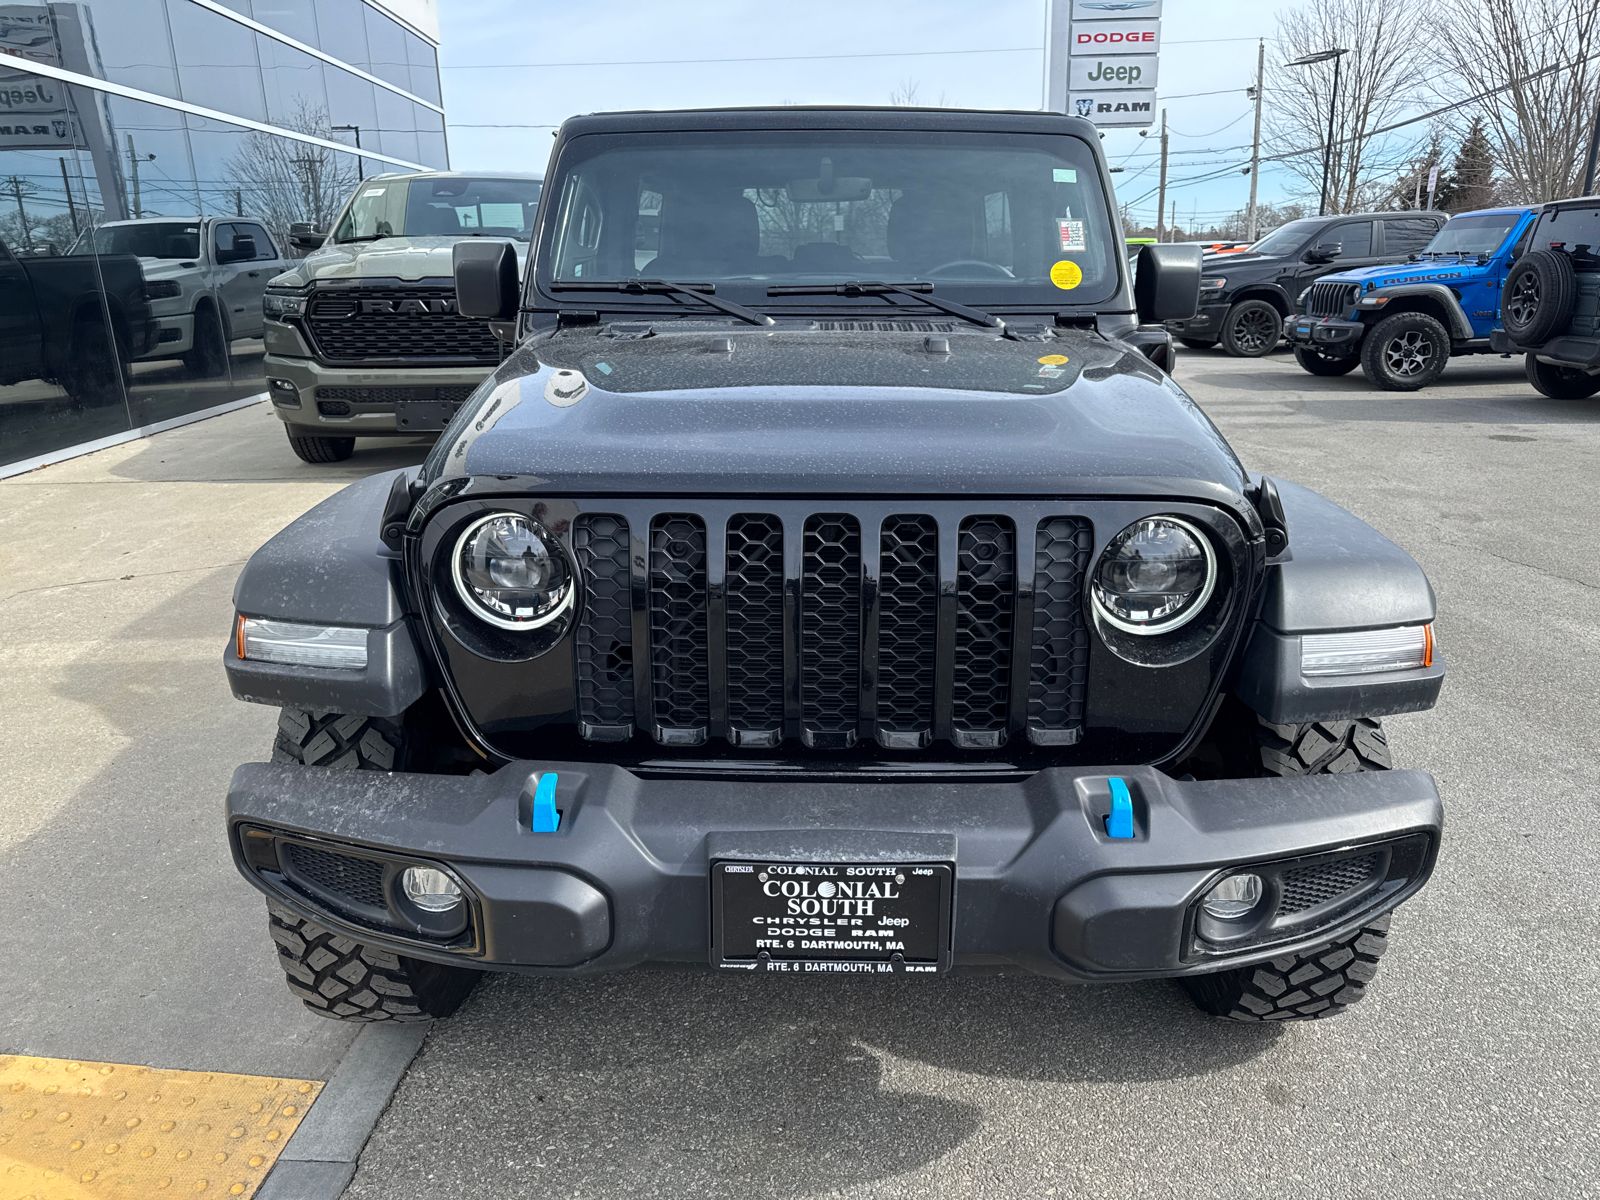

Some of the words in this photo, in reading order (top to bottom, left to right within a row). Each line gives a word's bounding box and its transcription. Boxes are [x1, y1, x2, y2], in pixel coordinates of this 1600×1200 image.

[1077, 32, 1155, 43] DODGE
[1087, 62, 1141, 84] Jeep
[1097, 102, 1150, 112] RAM
[1383, 272, 1462, 285] RUBICON
[361, 300, 459, 313] RAM
[767, 865, 838, 876] COLONIAL
[846, 867, 897, 876] SOUTH
[912, 867, 934, 876] Jeep
[763, 880, 899, 898] COLONIAL
[787, 898, 875, 916] SOUTH
[752, 917, 863, 926] CHRYSLER
[877, 916, 910, 928] Jeep
[767, 928, 836, 937] DODGE
[756, 939, 784, 948] RTE.
[786, 940, 795, 948] 6
[801, 940, 882, 951] DARTMOUTH,
[886, 942, 905, 950] MA
[766, 963, 791, 971] RTE.
[793, 963, 800, 971] 6
[804, 963, 875, 974] DARTMOUTH,
[877, 964, 894, 972] MA
